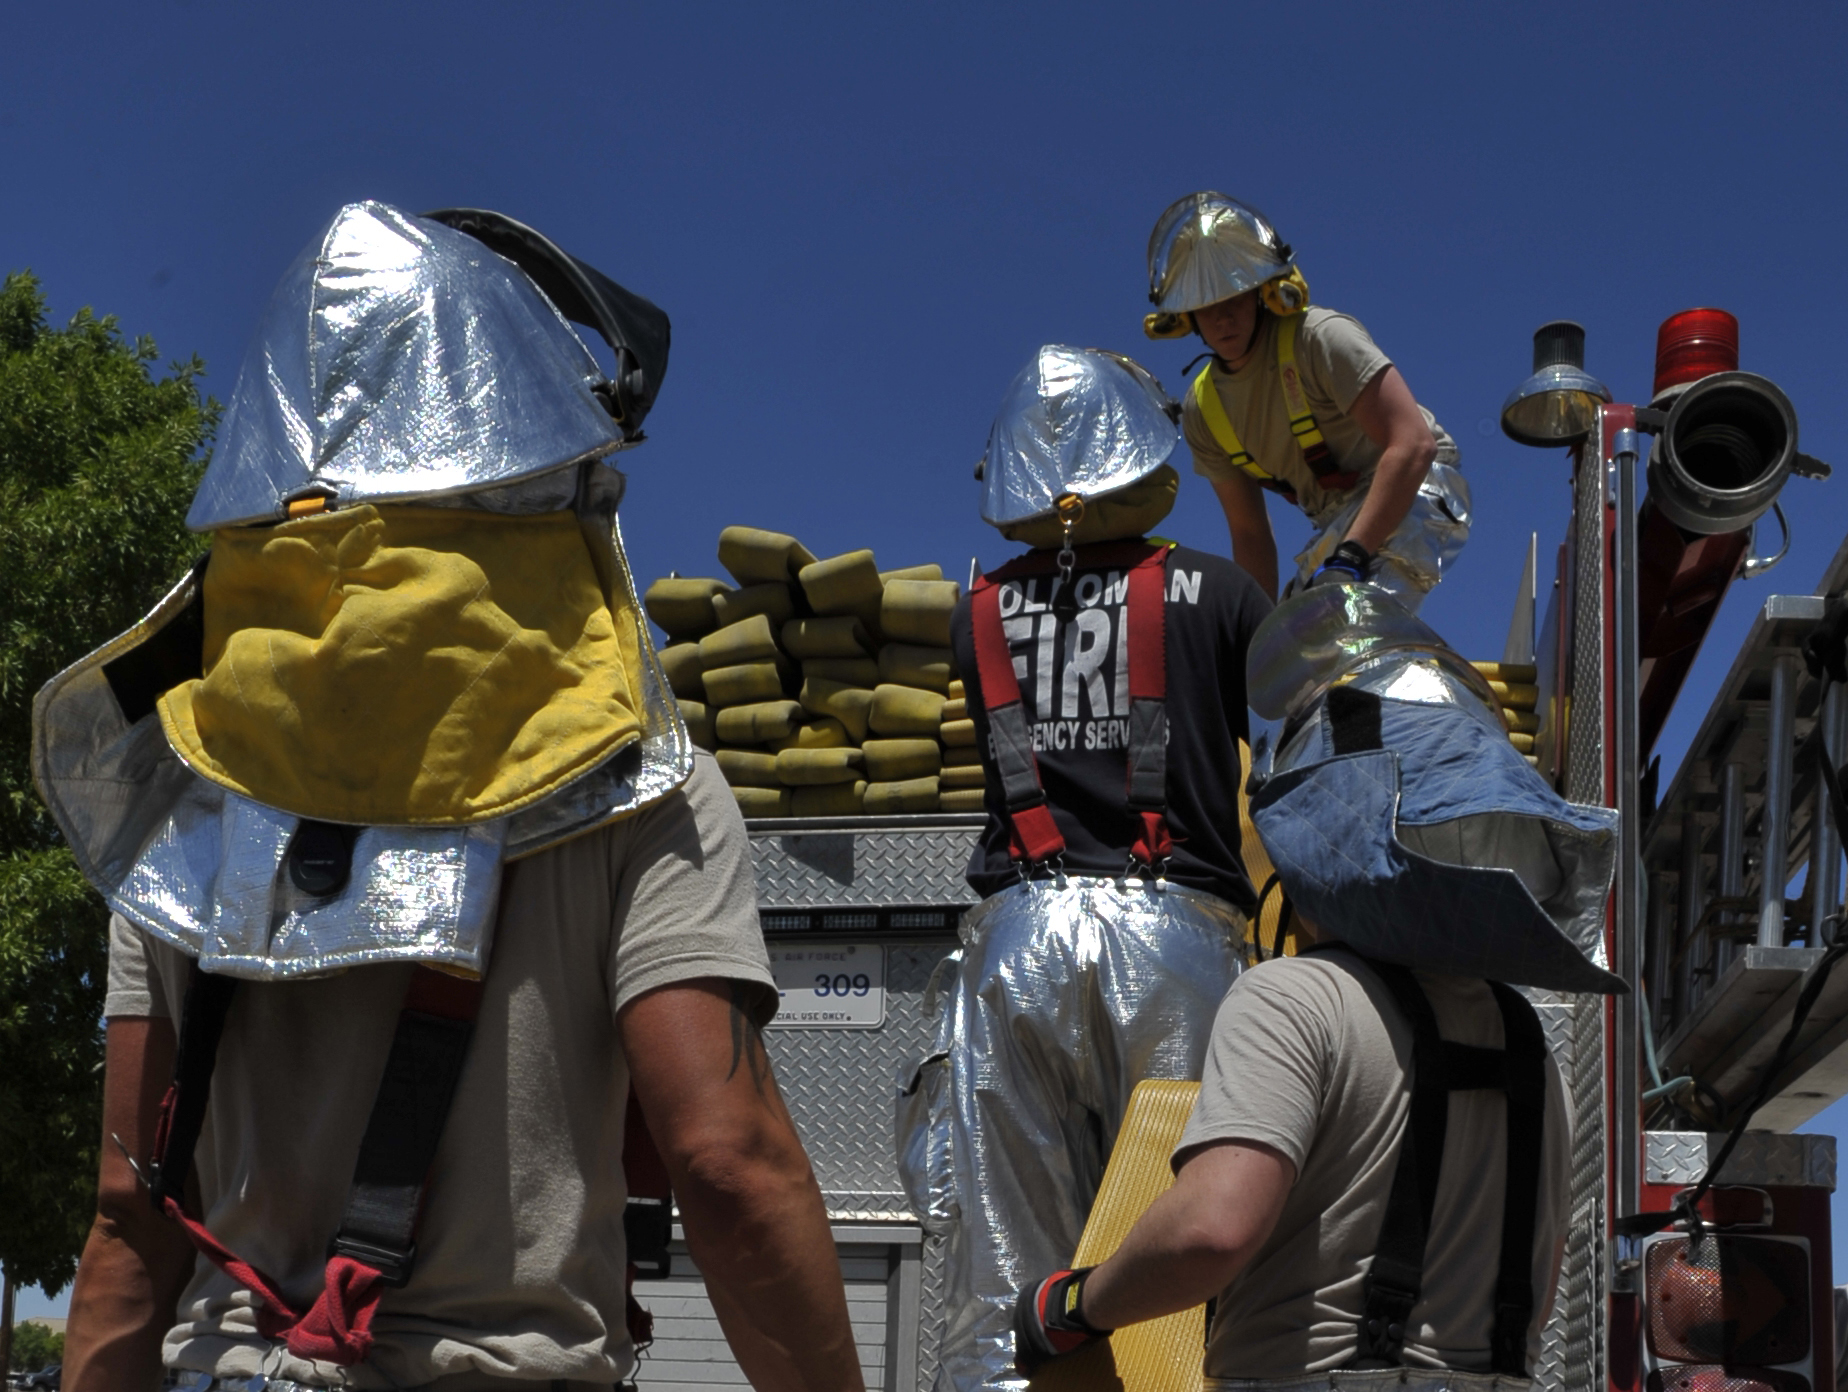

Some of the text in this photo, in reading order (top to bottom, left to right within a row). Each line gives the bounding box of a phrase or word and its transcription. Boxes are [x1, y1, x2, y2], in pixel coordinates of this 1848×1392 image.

[808, 953, 846, 962] FORCE
[814, 973, 870, 998] 309
[802, 1012, 820, 1021] USE
[822, 1012, 846, 1021] ONLY
